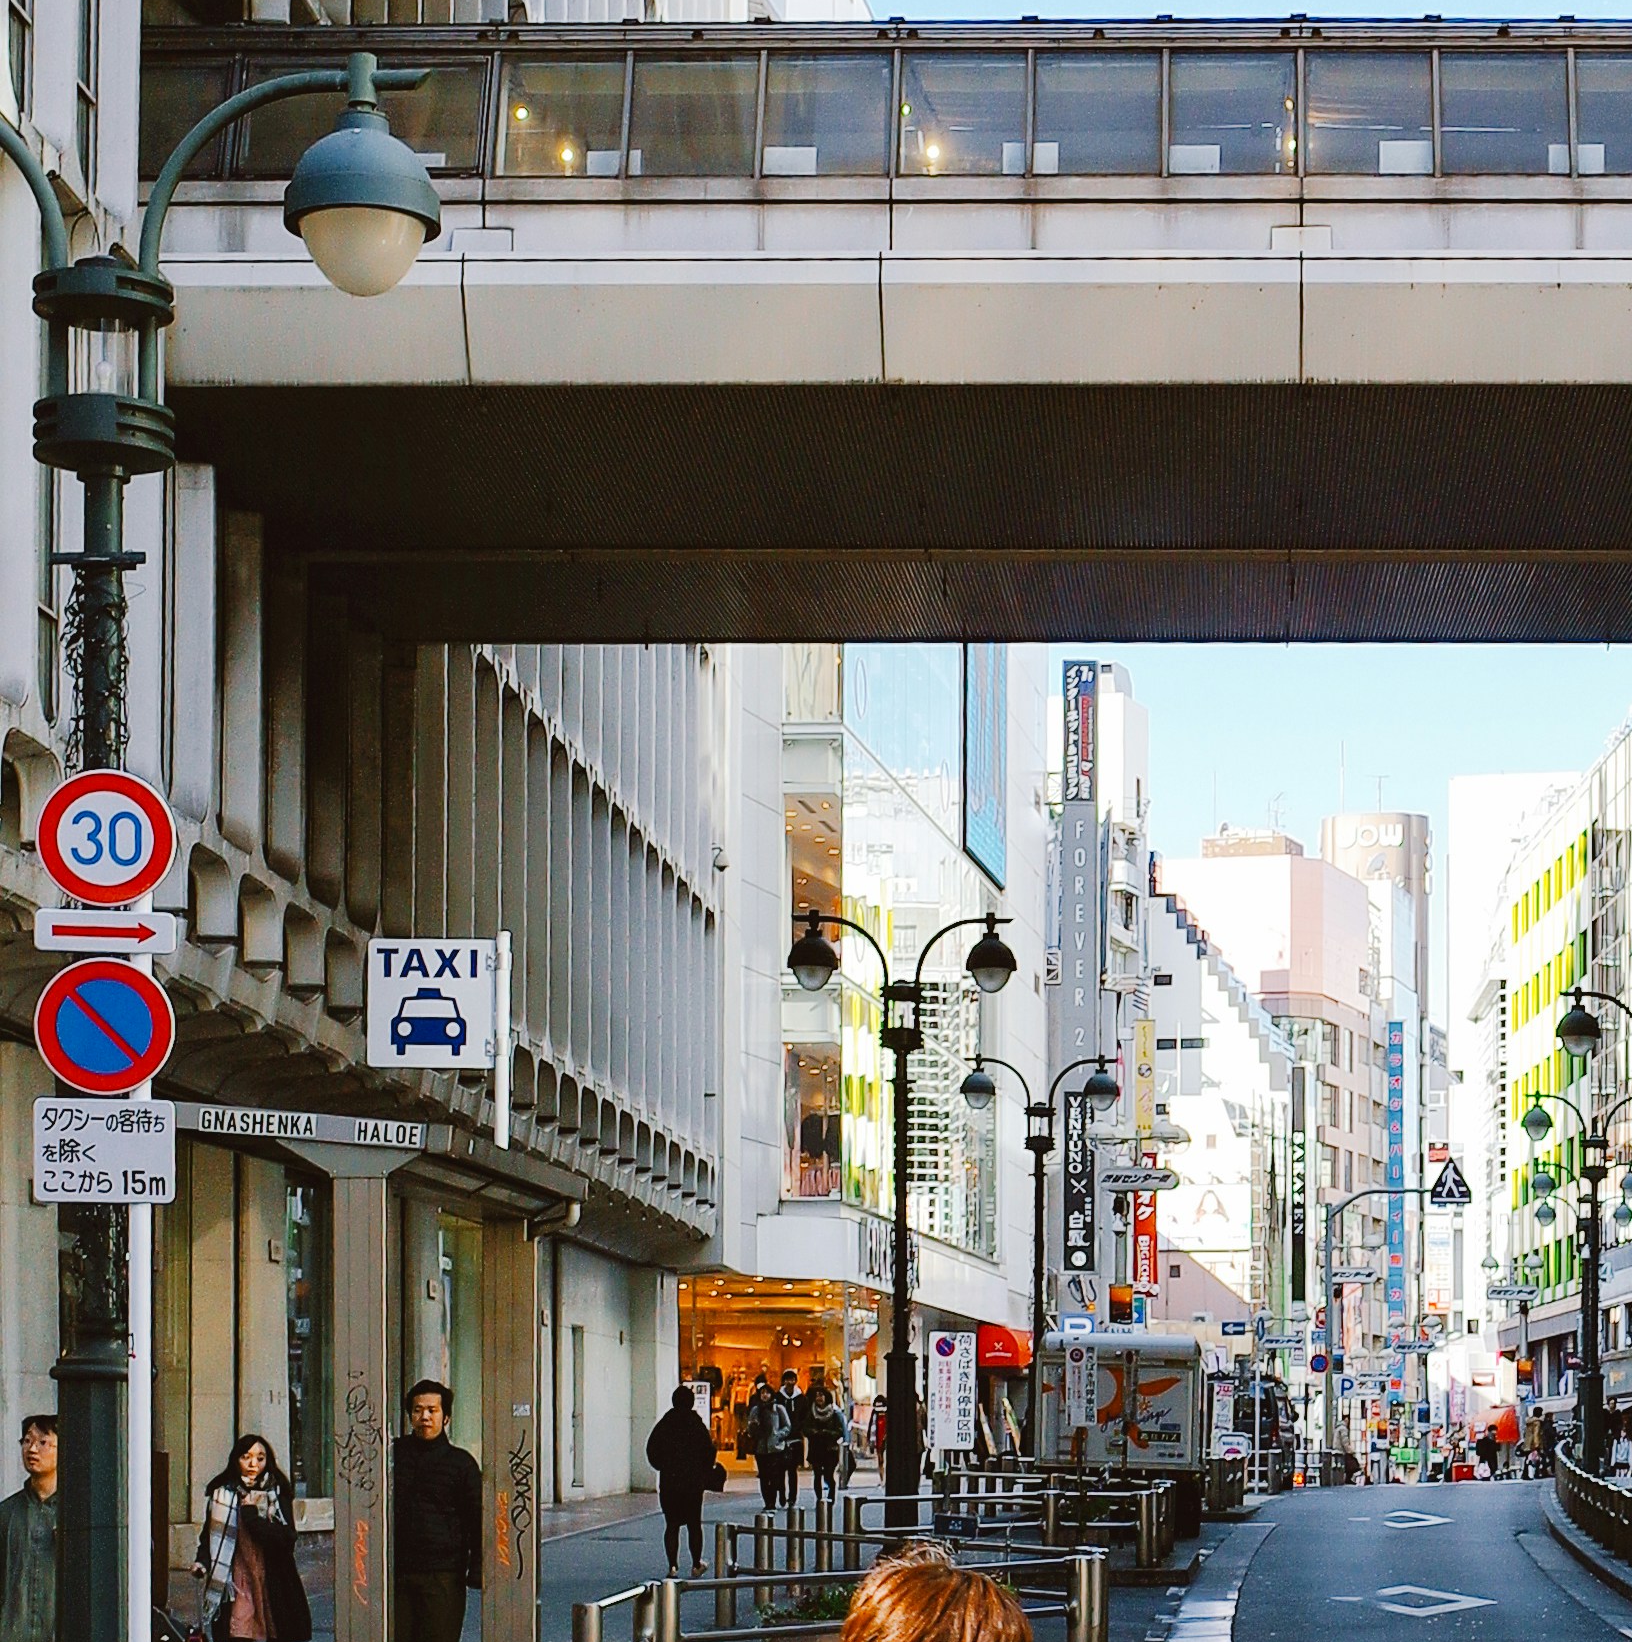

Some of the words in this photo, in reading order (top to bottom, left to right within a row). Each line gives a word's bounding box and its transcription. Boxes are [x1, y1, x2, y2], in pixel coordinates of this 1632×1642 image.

[70, 810, 142, 866] 30
[1074, 820, 1086, 1007] FOREVER
[377, 948, 478, 978] TAXI
[42, 1108, 165, 1133] タクシーの客待ち
[201, 1109, 314, 1137] GNASHENKA
[357, 1121, 419, 1145] HALOE
[1068, 1096, 1083, 1174] VENTUNO
[42, 1138, 96, 1163] を除く
[43, 1170, 113, 1194] ここから
[122, 1170, 166, 1196] 15m
[1293, 1131, 1304, 1235] SAKAZEN
[956, 1334, 972, 1443] 荷さばき用停車区間
[1341, 1378, 1354, 1396] P
